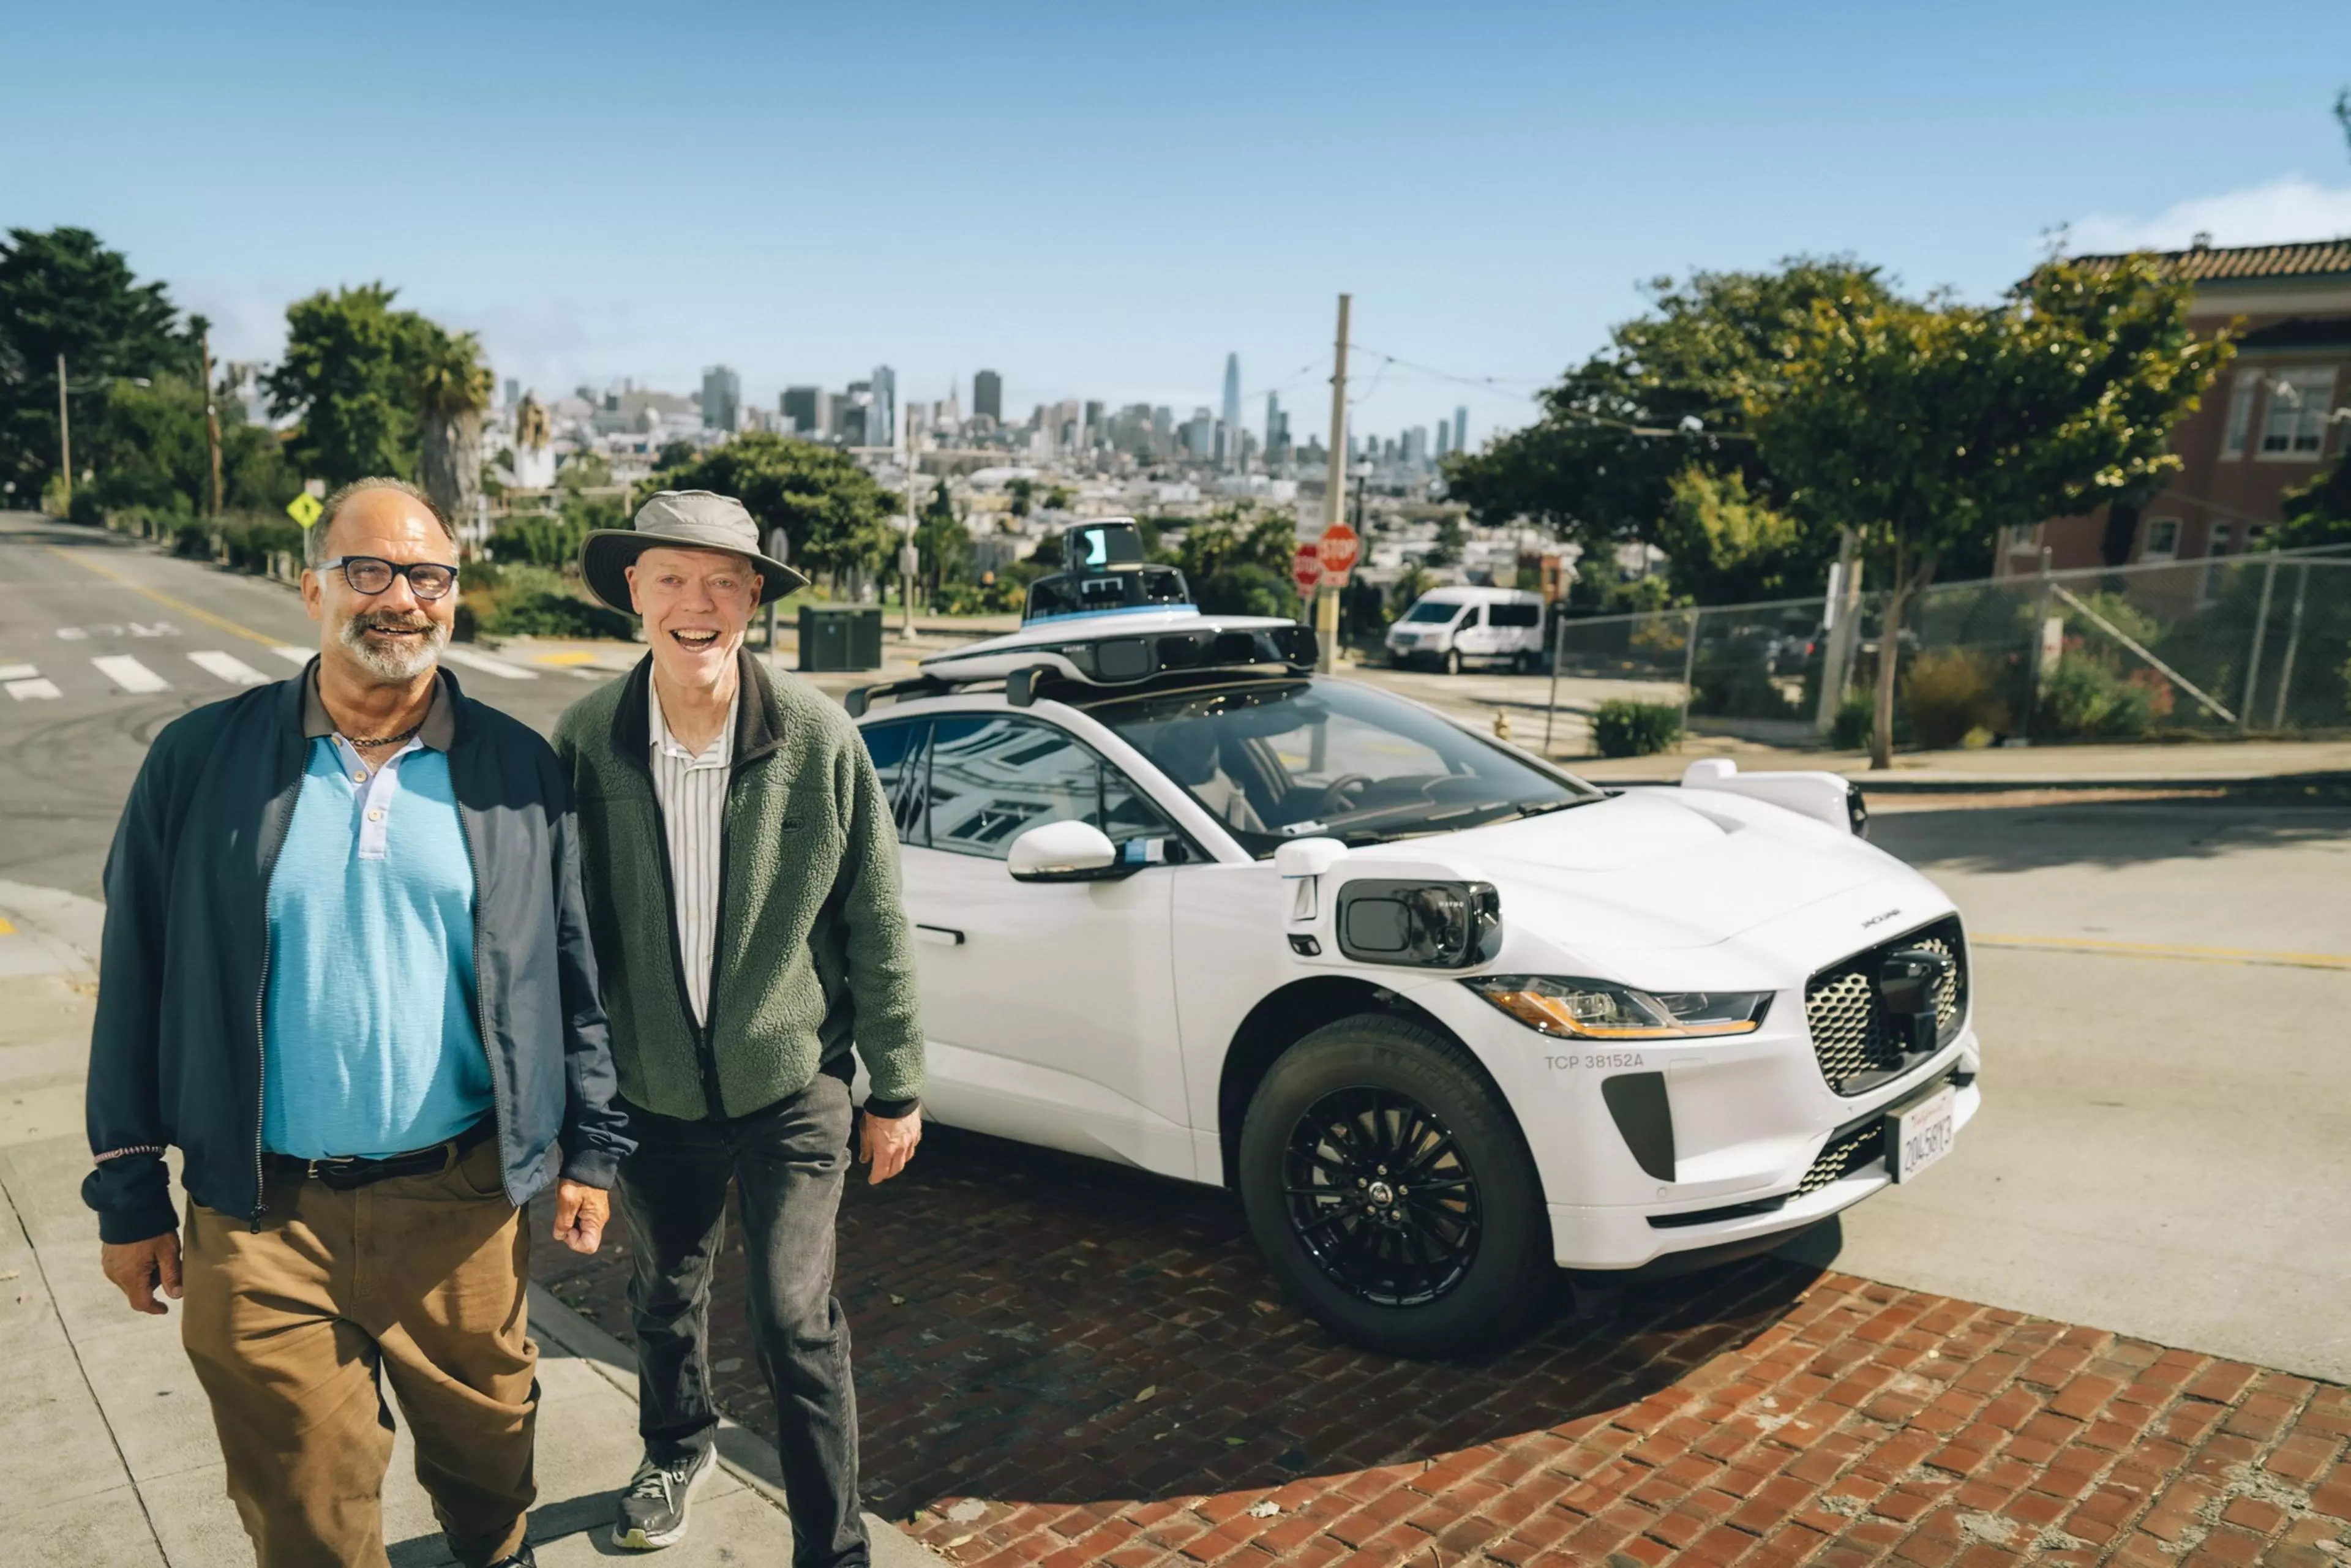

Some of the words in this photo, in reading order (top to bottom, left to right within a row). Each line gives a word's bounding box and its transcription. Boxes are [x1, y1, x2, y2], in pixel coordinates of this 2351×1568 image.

[1322, 539, 1358, 560] STOP
[1545, 1056, 1580, 1070] TCP
[1584, 1053, 1644, 1069] 38152A
